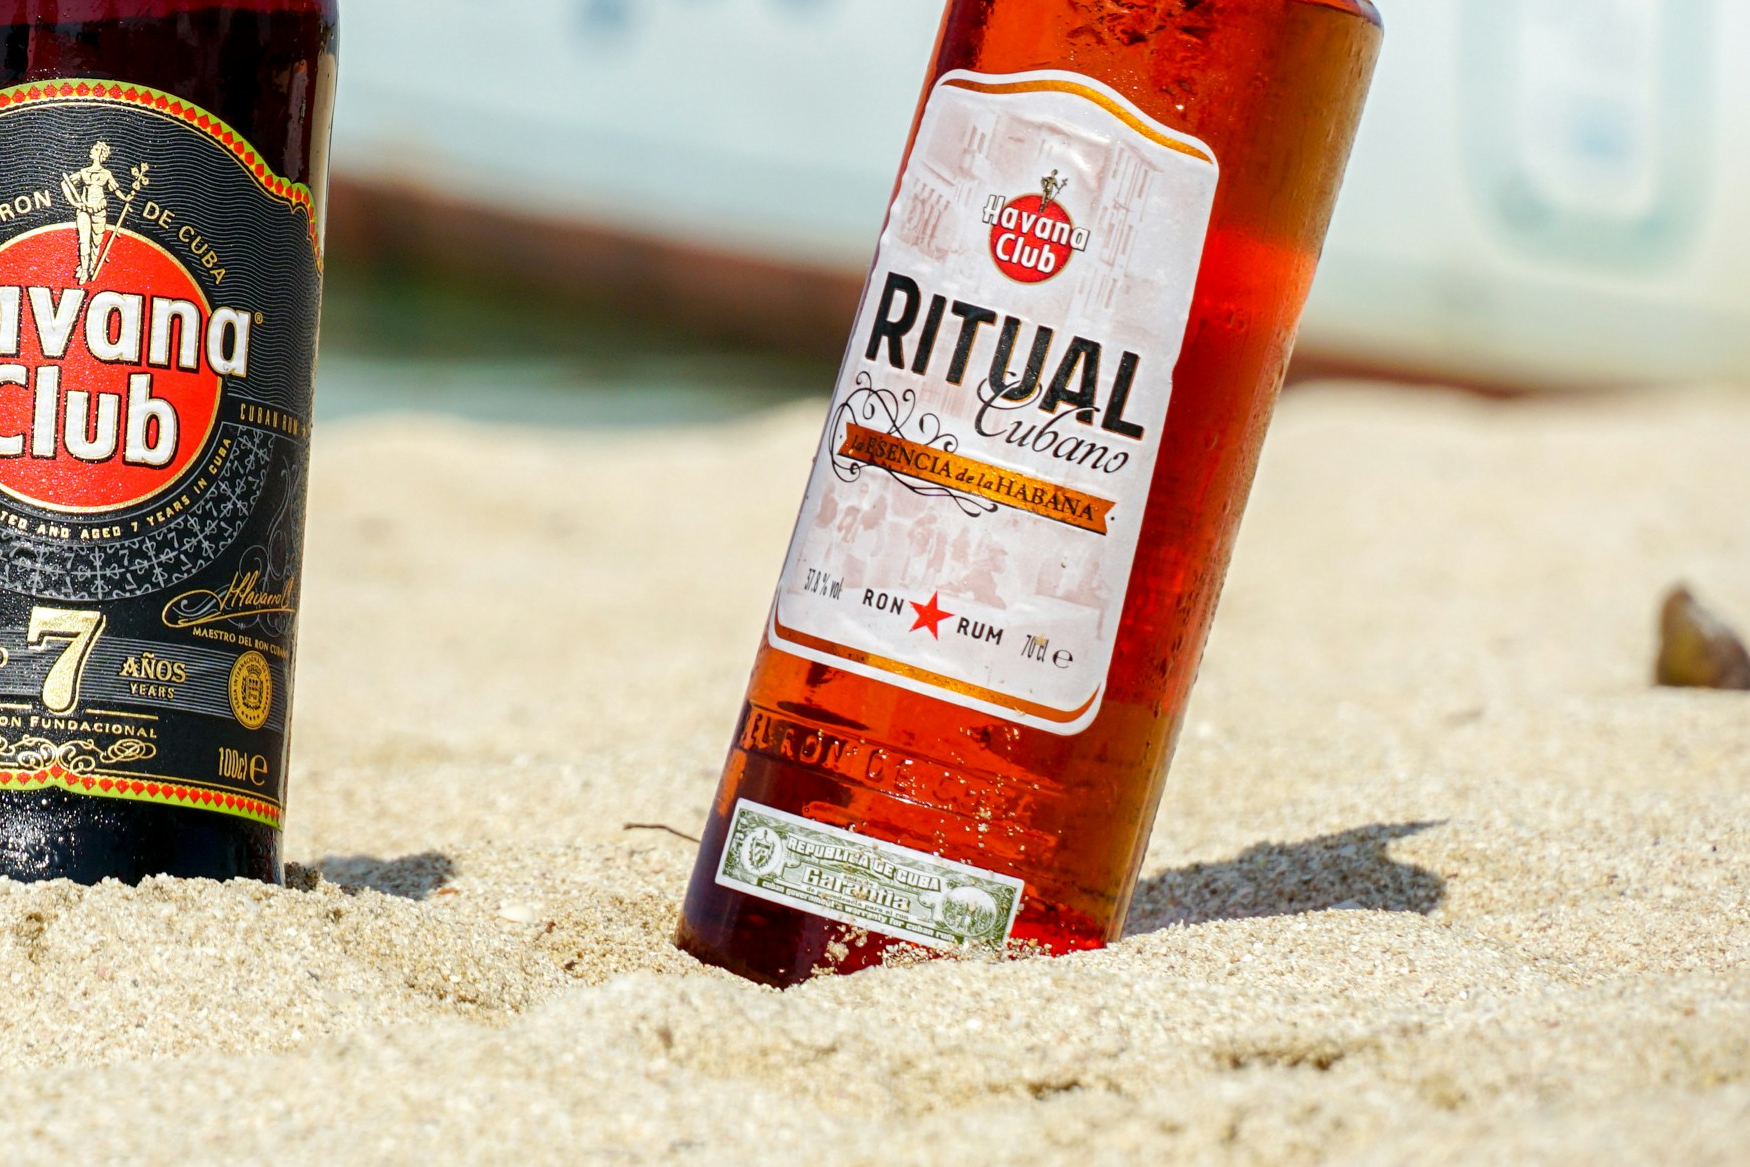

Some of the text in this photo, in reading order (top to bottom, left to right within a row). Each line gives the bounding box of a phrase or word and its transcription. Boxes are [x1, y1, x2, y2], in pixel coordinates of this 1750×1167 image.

[142, 201, 176, 230] DE
[177, 225, 227, 285] CUBA
[982, 194, 1090, 252] Havana
[996, 232, 1056, 273] Club
[864, 270, 1145, 441] RITUAL
[240, 402, 278, 428] CUBAN
[974, 371, 1130, 474] Cubano
[36, 524, 70, 539] AND
[80, 525, 121, 539] AGED
[131, 521, 139, 532] 7
[146, 494, 191, 526] YEARS
[193, 477, 208, 494] IN
[208, 438, 232, 475] CUBA
[865, 437, 952, 478] ESENCIA
[993, 476, 1094, 521] HABANA
[862, 588, 905, 615] RON
[192, 627, 236, 643] MAESTRO
[238, 637, 253, 647] DEL
[254, 639, 269, 653] RON
[956, 617, 1004, 645] RUM
[26, 606, 107, 716] 7
[118, 651, 187, 684] AÑOS
[130, 683, 175, 700] YEARS
[30, 715, 158, 739] FUNDACIONAL
[787, 836, 870, 870] REPUBLICA
[896, 867, 941, 892] CUBA
